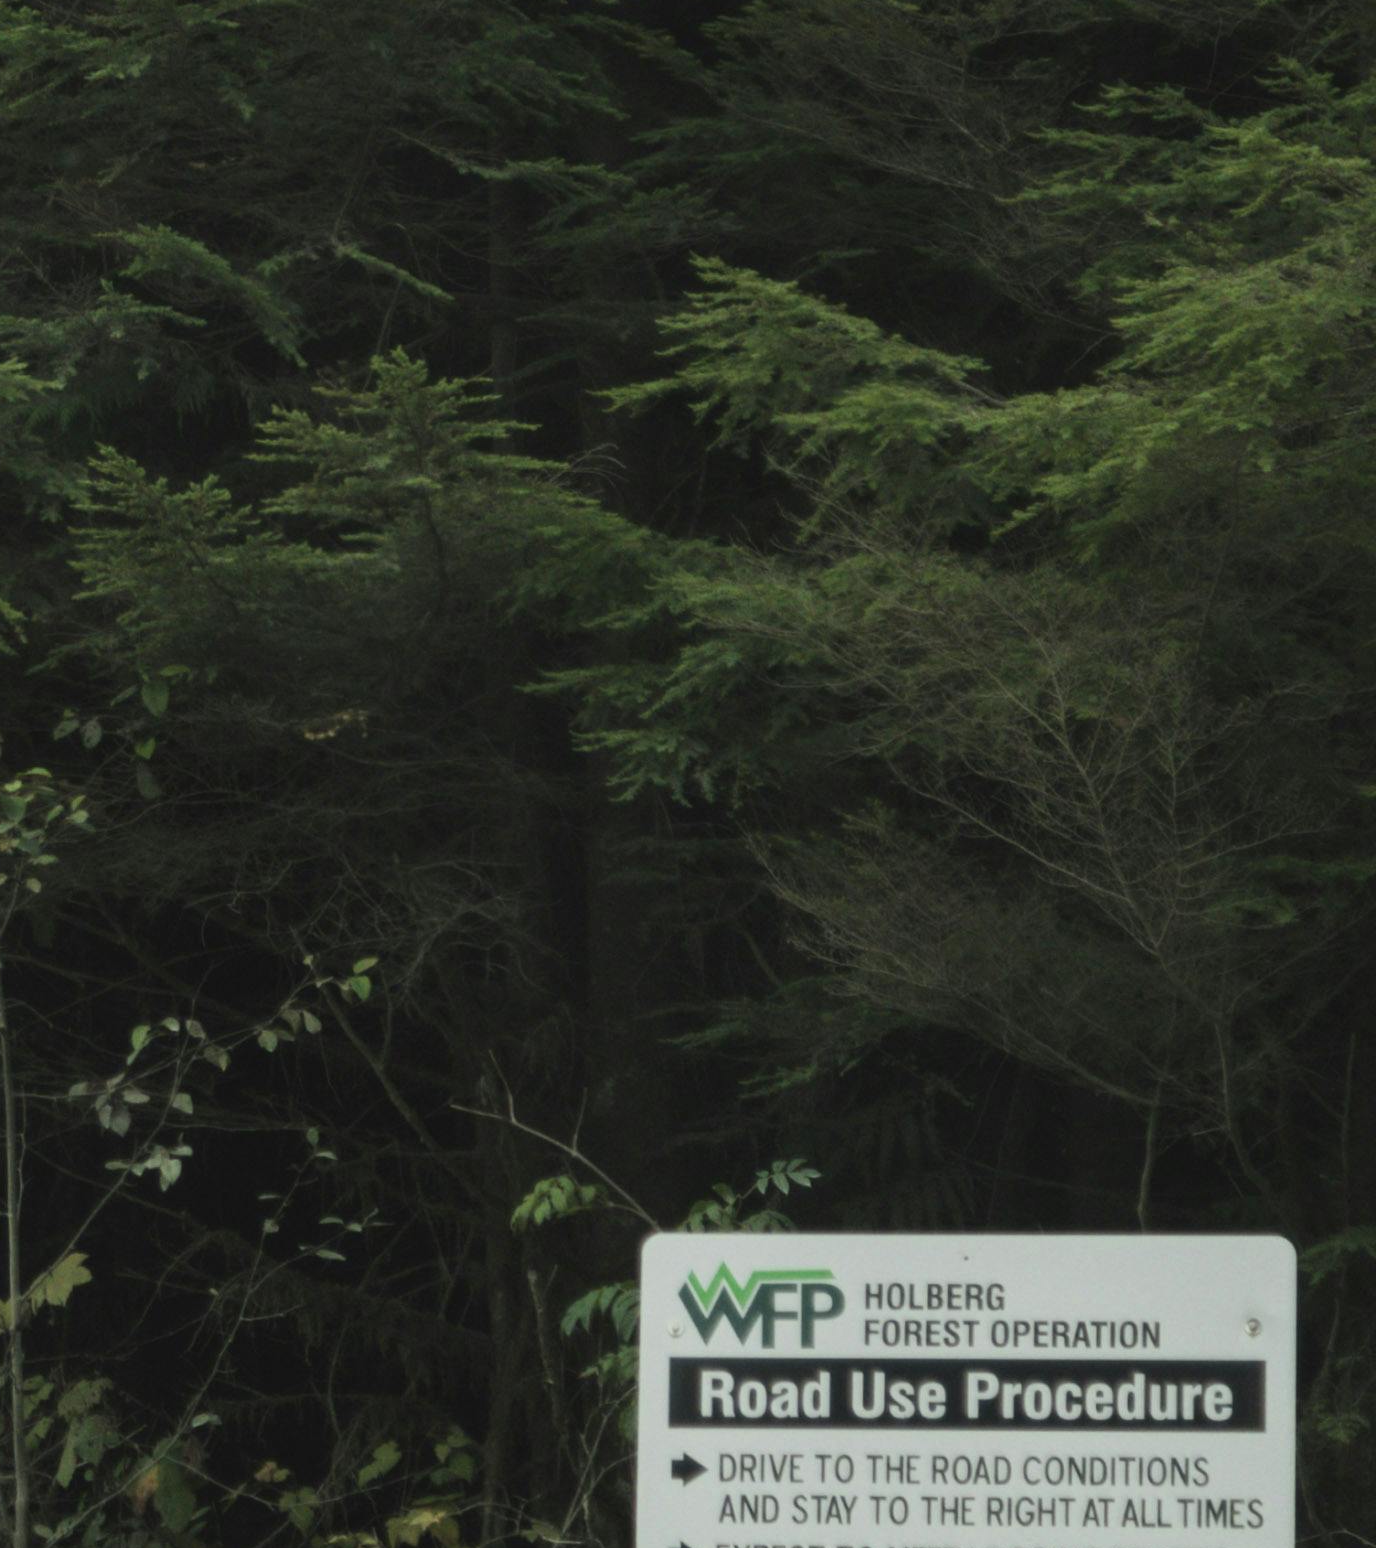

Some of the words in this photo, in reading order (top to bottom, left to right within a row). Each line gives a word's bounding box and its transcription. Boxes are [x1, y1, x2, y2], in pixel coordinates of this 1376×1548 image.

[677, 1261, 847, 1351] WFP
[863, 1282, 1006, 1312] HOLBERG
[863, 1319, 982, 1349] FOREST
[990, 1319, 1162, 1350] OPERATION
[699, 1369, 831, 1421] Road
[850, 1369, 947, 1423] Use
[965, 1370, 1235, 1424] Procedure
[717, 1453, 804, 1485] DRIVE
[814, 1453, 855, 1485] TO
[866, 1454, 922, 1486] THE
[931, 1454, 1013, 1487] ROAD
[1022, 1455, 1211, 1489] CONDITIONS
[717, 1493, 781, 1527] AND
[791, 1494, 859, 1527] STAY
[868, 1496, 911, 1528] TO
[921, 1496, 976, 1528] THE
[986, 1496, 1075, 1530] RIGHT
[1080, 1497, 1121, 1530] AT
[1121, 1497, 1176, 1531] ALL
[1178, 1497, 1265, 1533] TIMES
